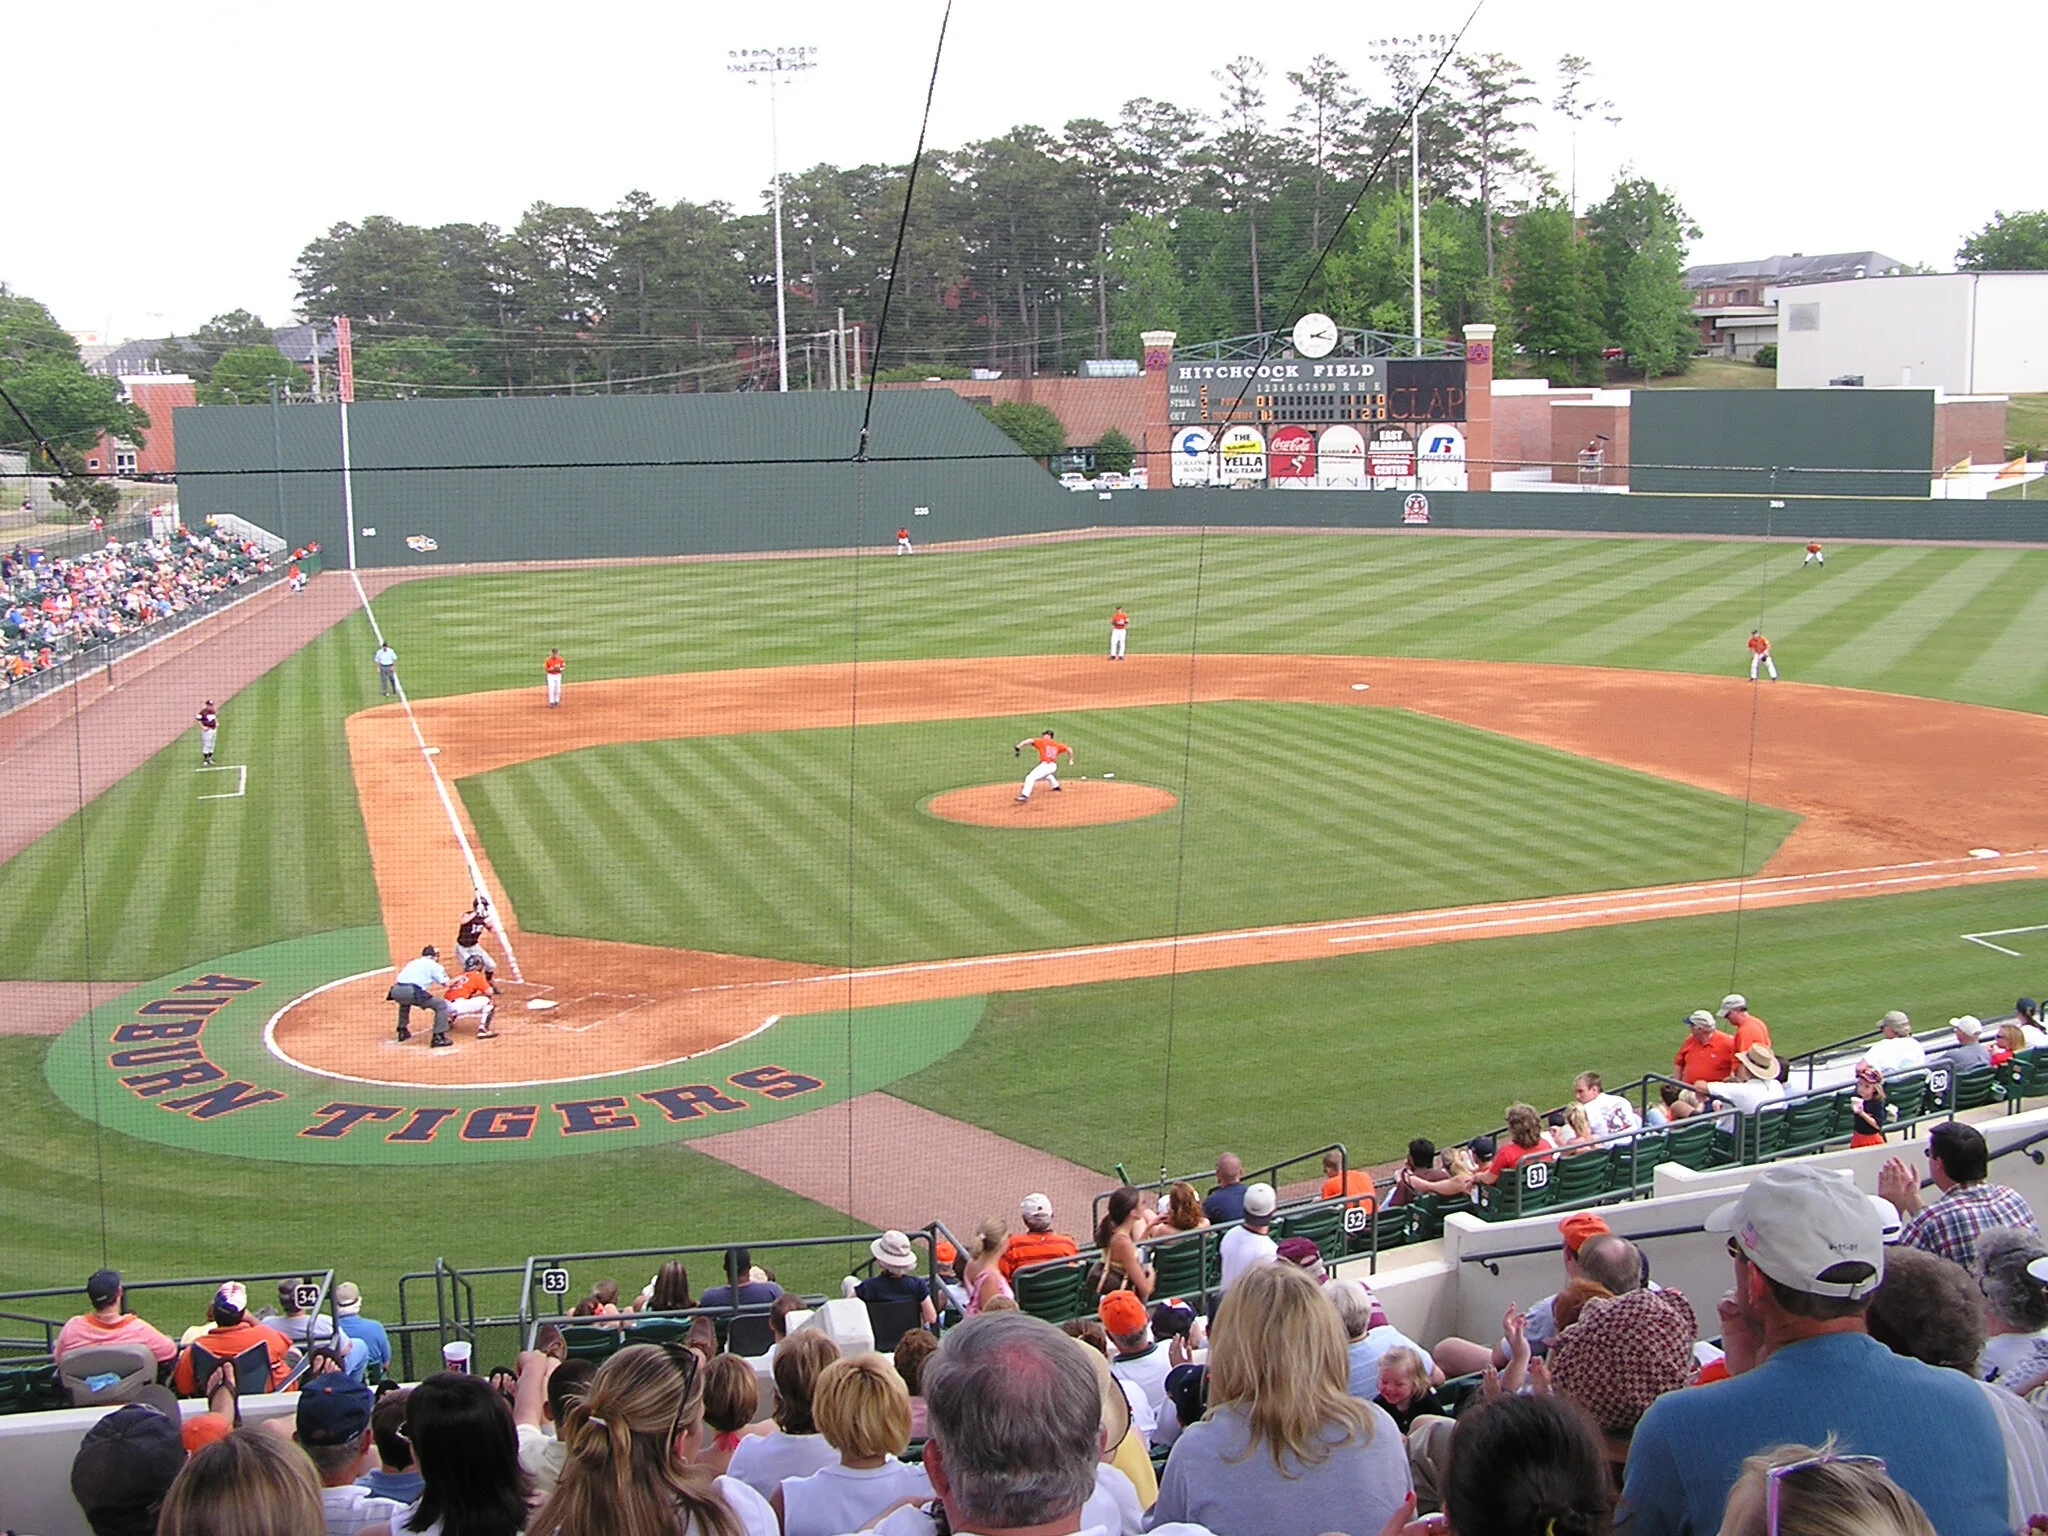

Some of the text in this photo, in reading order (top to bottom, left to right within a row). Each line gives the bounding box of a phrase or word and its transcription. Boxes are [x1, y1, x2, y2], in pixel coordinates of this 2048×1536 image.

[1179, 364, 1375, 380] HITCHCOCK FIELD
[1389, 387, 1464, 419] CLAP
[1170, 411, 1186, 420] OUT
[1379, 430, 1404, 441] EAST
[1224, 456, 1263, 466] YELLA
[108, 973, 825, 1143] AUBURN TIGERS
[1530, 1167, 1544, 1184] 31
[1347, 1212, 1363, 1227] 32
[547, 1274, 565, 1289] 33
[298, 1290, 317, 1304] 34
